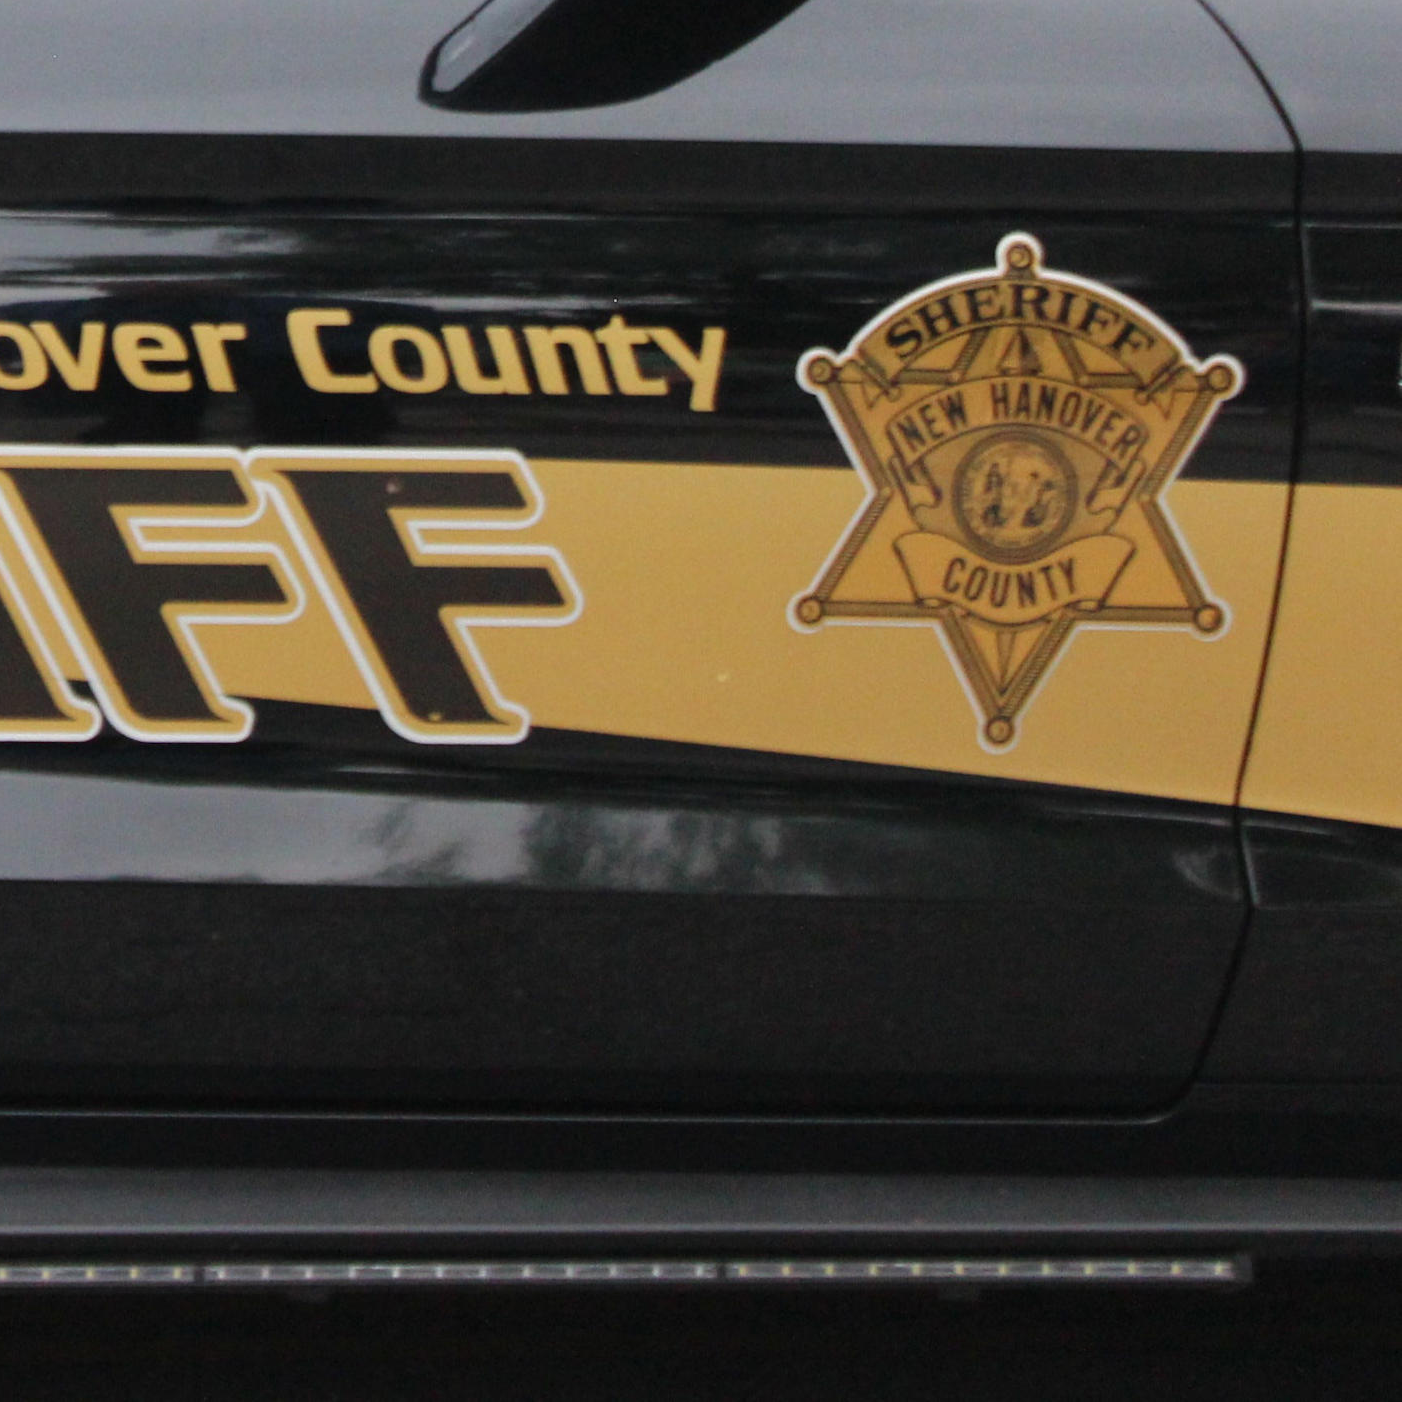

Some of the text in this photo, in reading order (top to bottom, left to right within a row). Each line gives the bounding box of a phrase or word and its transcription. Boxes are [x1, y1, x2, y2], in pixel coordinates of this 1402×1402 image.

[286, 308, 726, 413] County
[885, 283, 1157, 361] SHERIFF
[898, 381, 1142, 466] NEW HANOVER
[942, 556, 1077, 608] COUNTY
